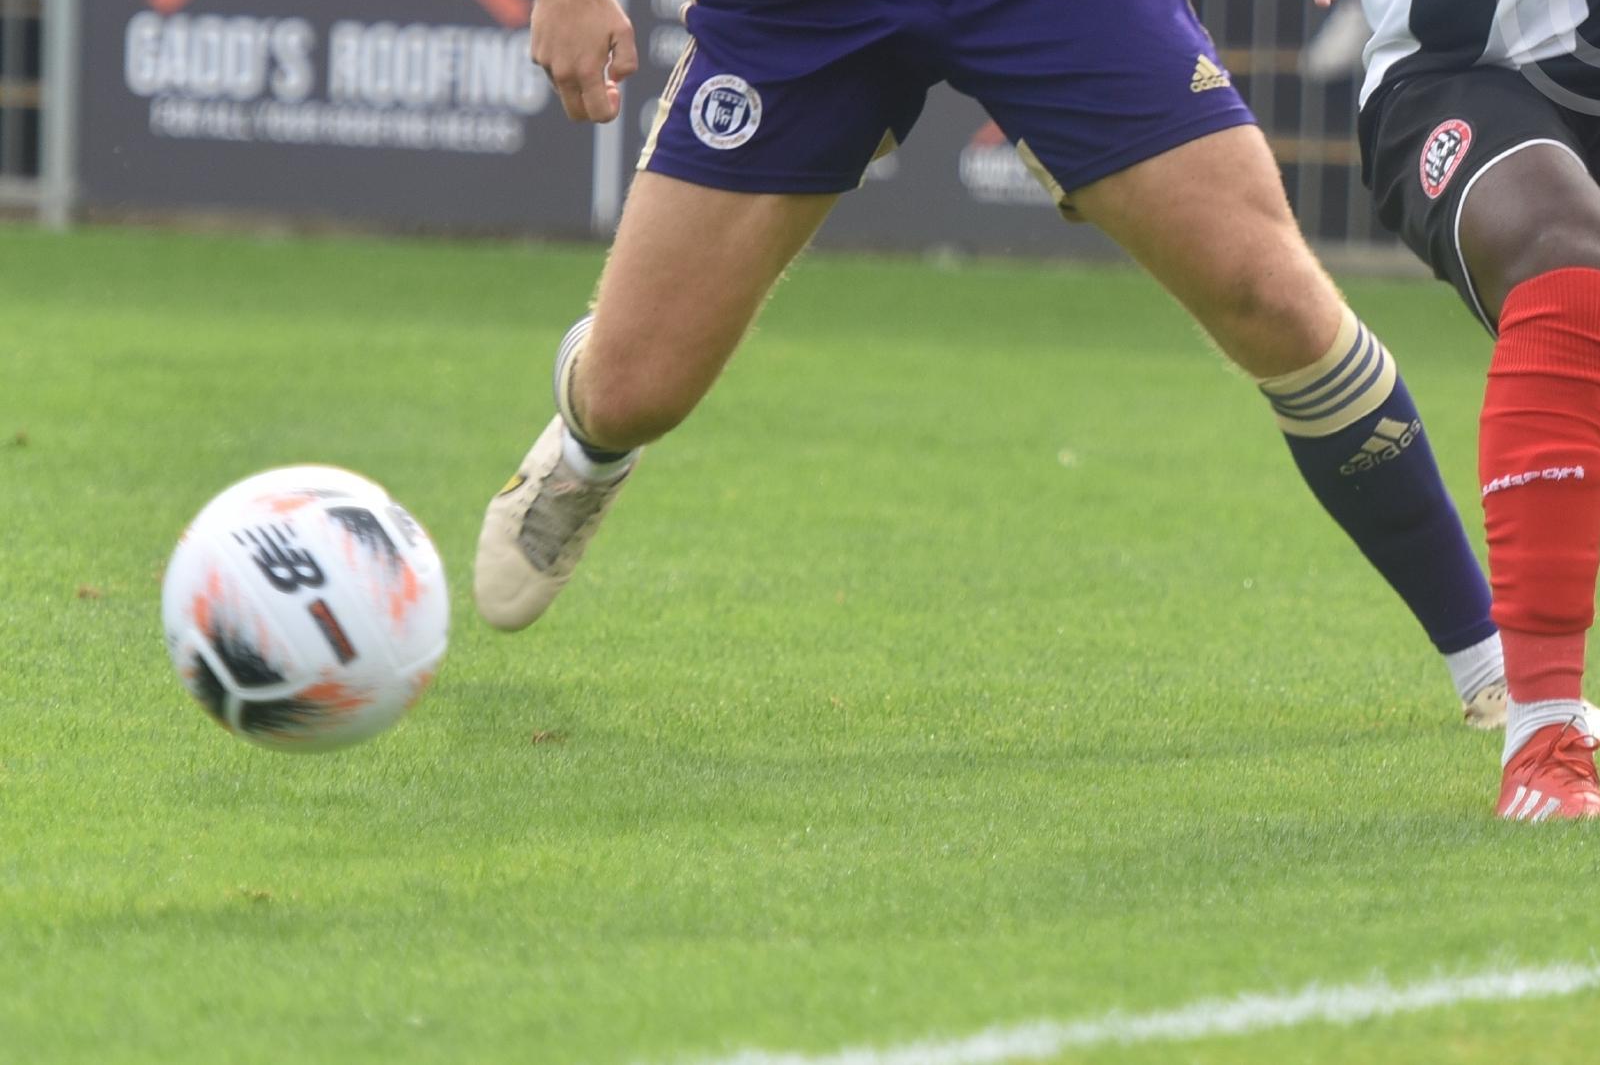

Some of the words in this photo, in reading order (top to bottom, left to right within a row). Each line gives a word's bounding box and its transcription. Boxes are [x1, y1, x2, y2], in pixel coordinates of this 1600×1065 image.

[128, 13, 314, 100] GADD'S
[330, 22, 546, 111] ROOFING
[1339, 418, 1422, 475] adidas
